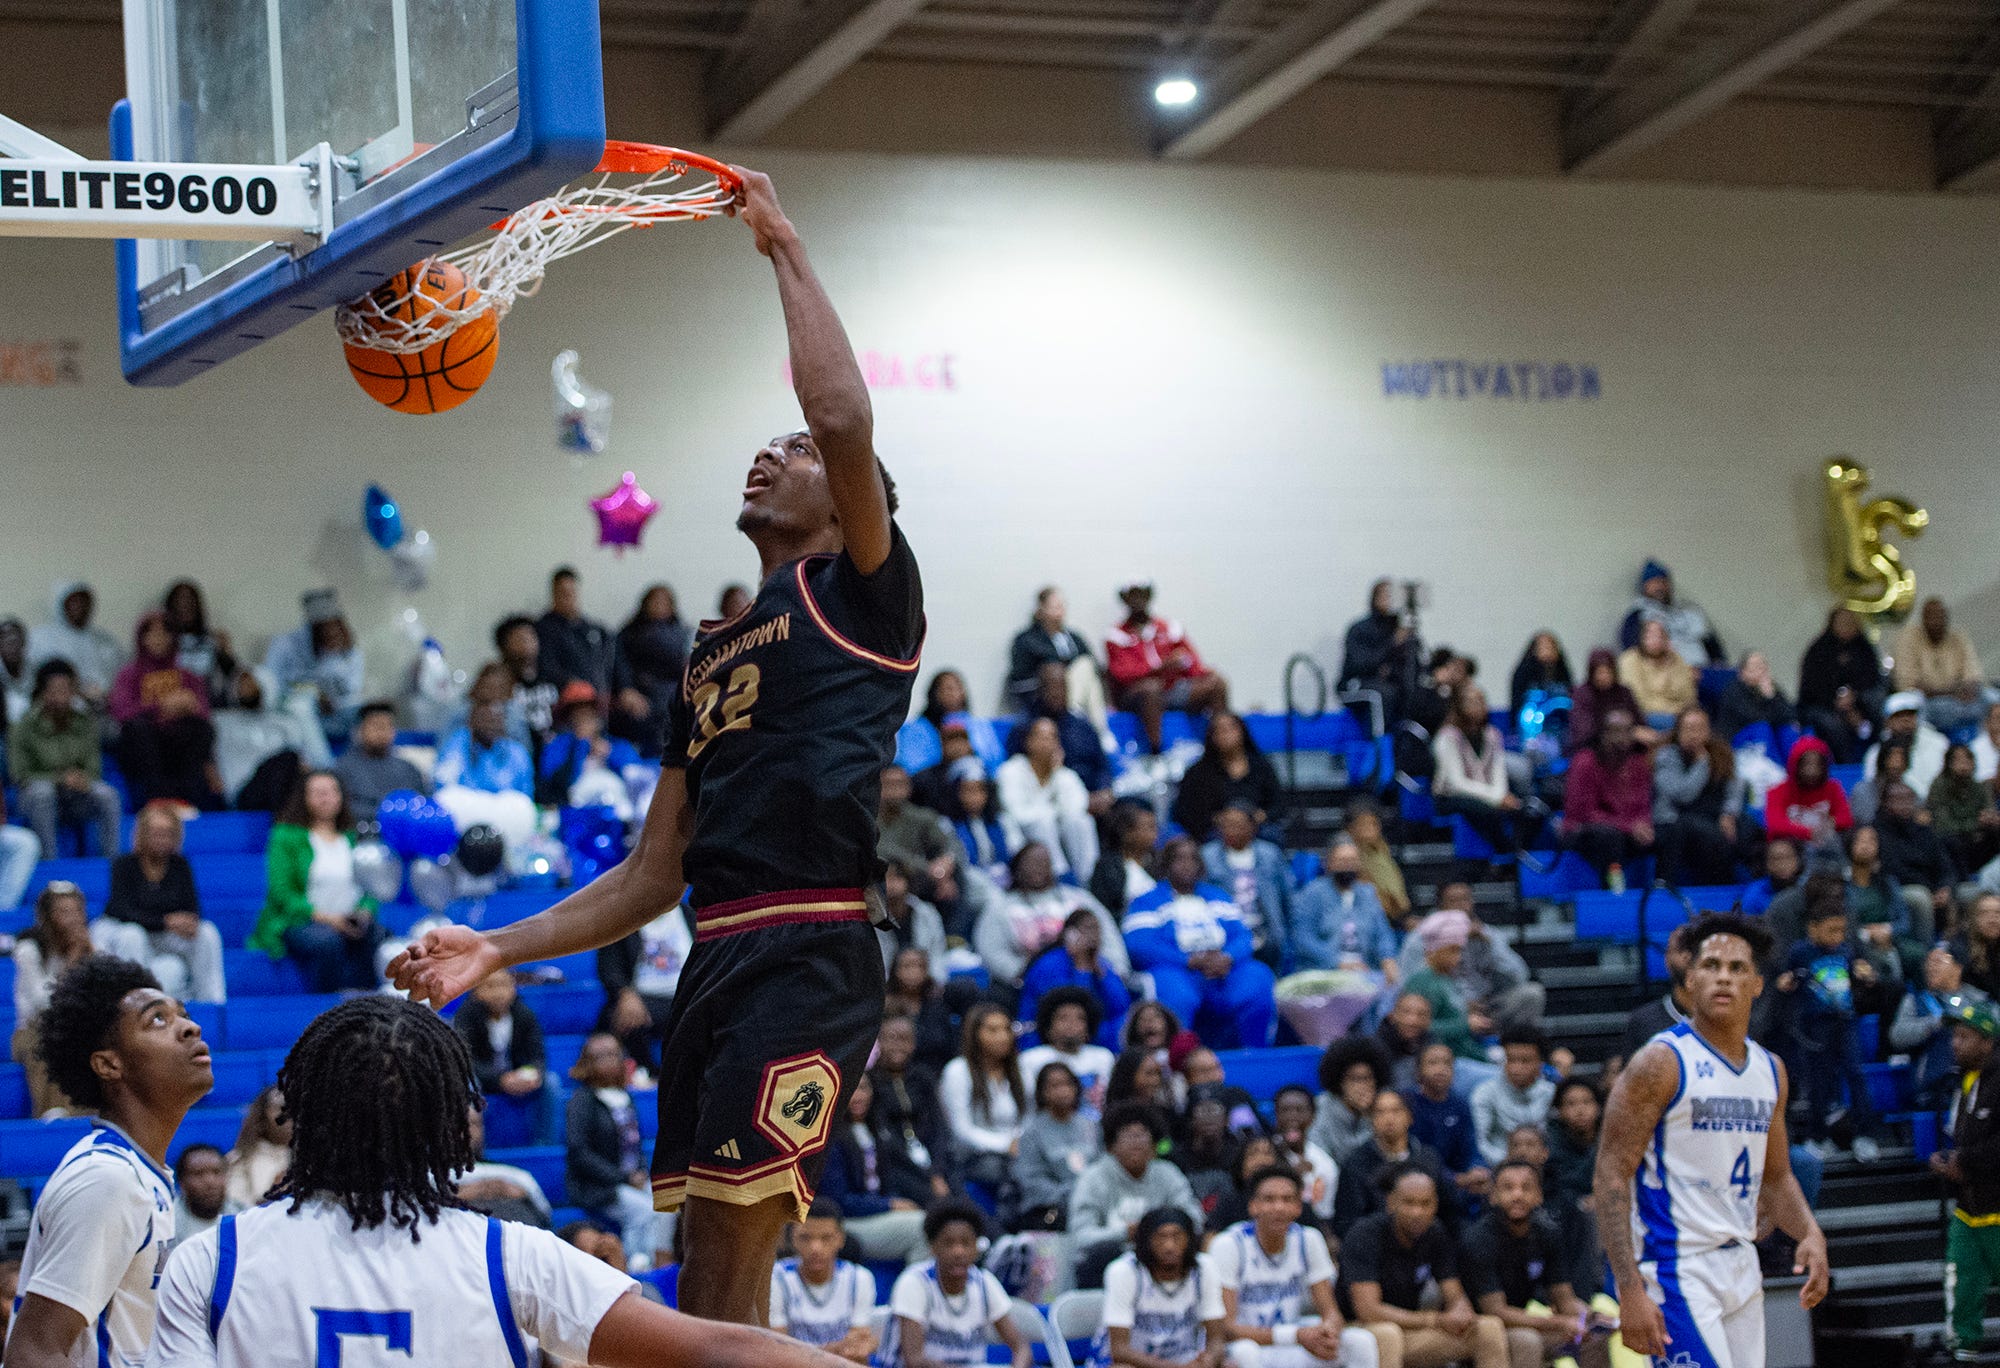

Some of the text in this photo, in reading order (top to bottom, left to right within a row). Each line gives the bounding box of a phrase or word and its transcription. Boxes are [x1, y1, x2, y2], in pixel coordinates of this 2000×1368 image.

[0, 169, 278, 216] ELITE9600
[1381, 359, 1601, 400] MOTIVATION
[1730, 1146, 1751, 1199] 4
